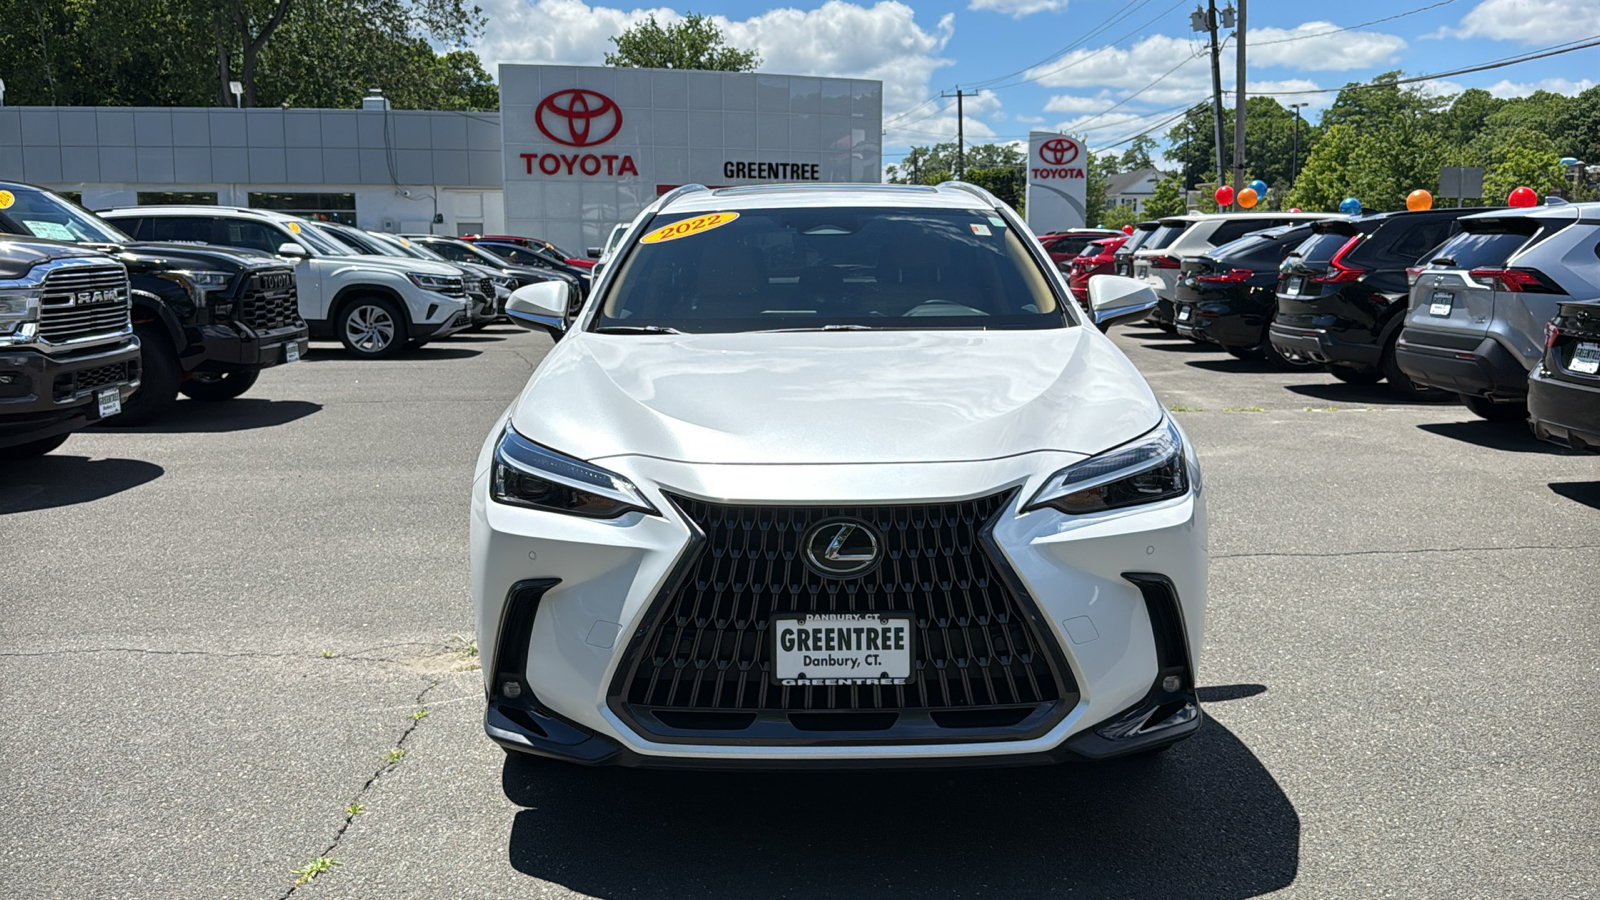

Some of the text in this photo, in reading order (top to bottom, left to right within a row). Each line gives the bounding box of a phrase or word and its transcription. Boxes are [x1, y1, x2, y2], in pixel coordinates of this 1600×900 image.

[520, 153, 639, 176] TOYOTA
[723, 161, 820, 181] GREENTREE
[1031, 168, 1085, 179] TOYOTA
[660, 215, 722, 240] 2022
[263, 274, 291, 289] TOYOTA
[77, 290, 118, 304] RAM
[806, 613, 881, 621] DANBURY, CT
[780, 627, 905, 652] GREENTREE
[803, 653, 882, 669] Danbury, CT.
[781, 678, 906, 686] GREENTREE
